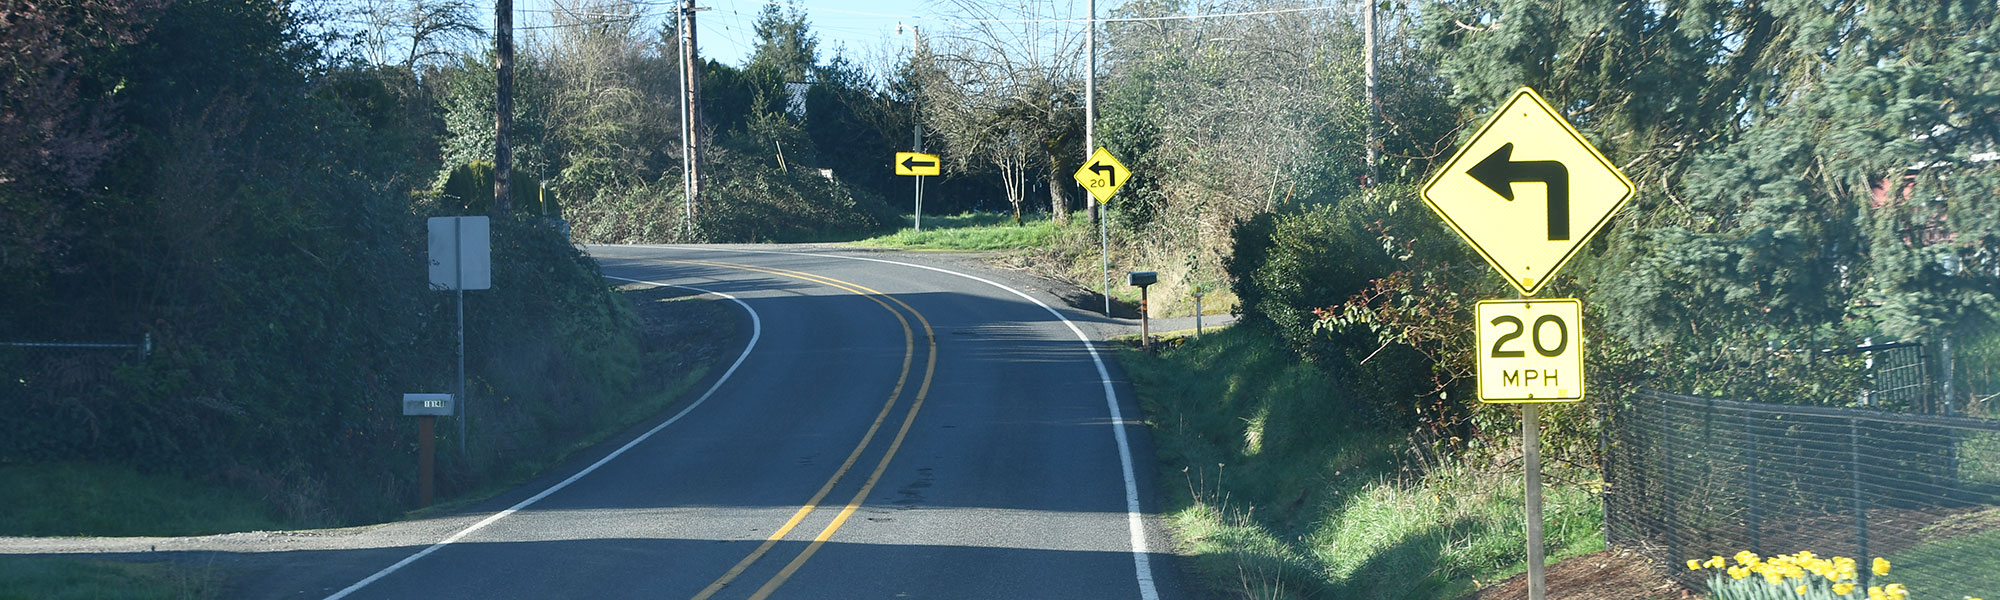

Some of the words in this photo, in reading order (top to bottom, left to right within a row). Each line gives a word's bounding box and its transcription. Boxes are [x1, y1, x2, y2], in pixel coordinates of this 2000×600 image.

[1090, 178, 1105, 188] 20
[1490, 314, 1568, 358] 20
[1503, 369, 1558, 387] MPH
